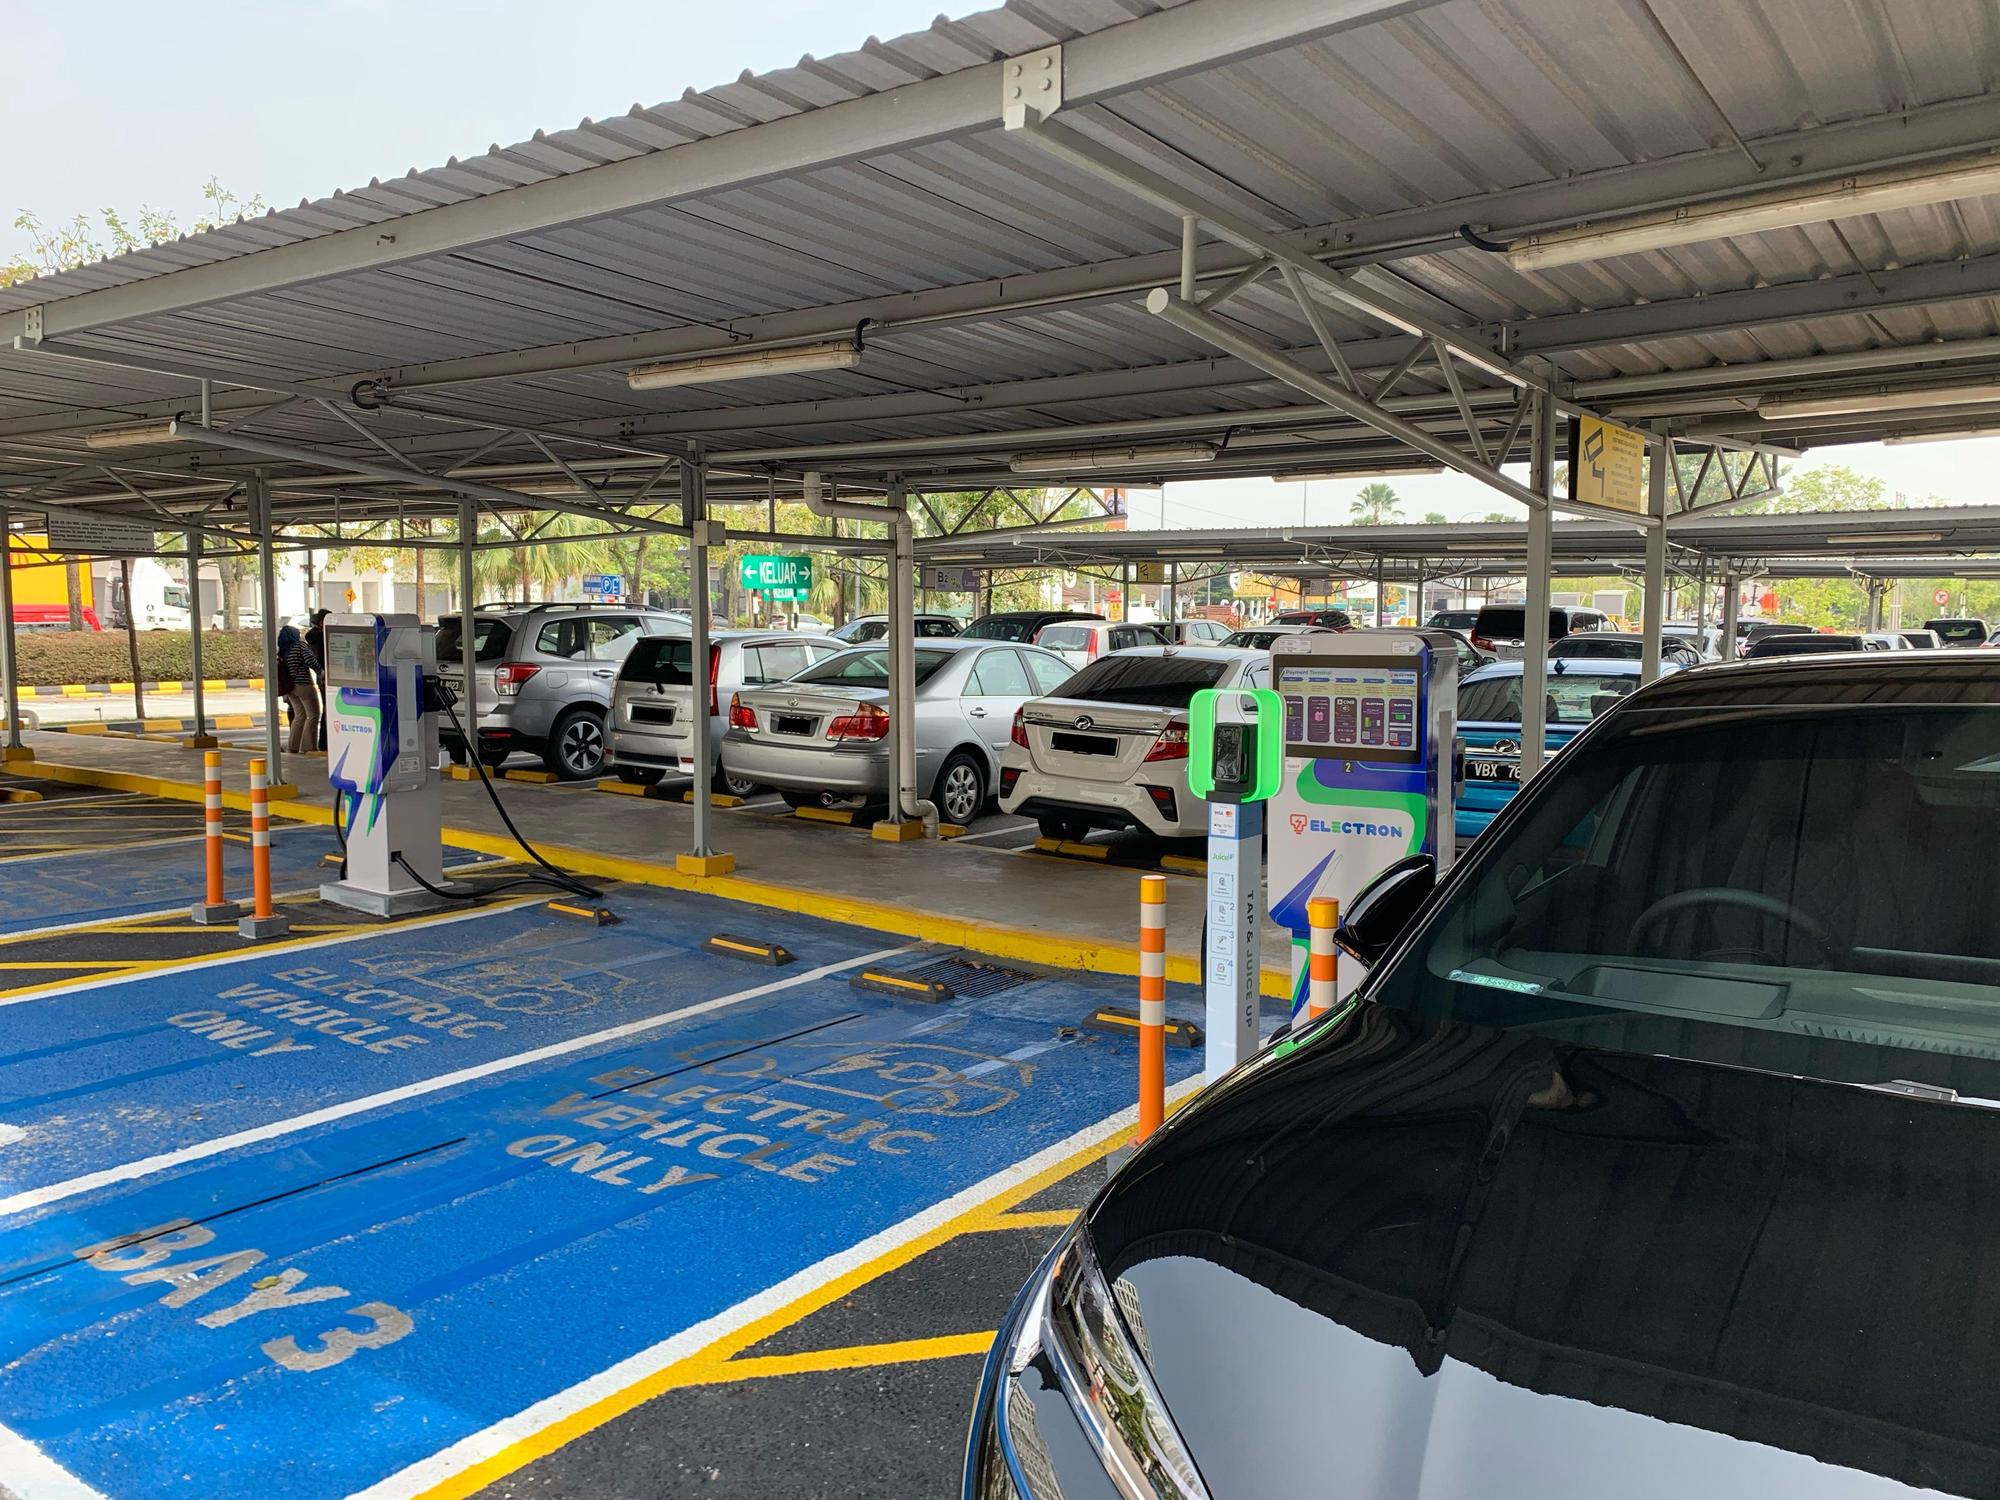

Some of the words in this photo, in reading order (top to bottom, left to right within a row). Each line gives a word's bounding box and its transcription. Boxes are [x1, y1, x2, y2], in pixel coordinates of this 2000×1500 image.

[759, 561, 798, 585] KELUAR
[341, 724, 373, 734] ELECTRON
[1345, 762, 1351, 773] 2
[1475, 763, 1498, 777] VBX
[1310, 819, 1403, 838] ELECTRON
[1246, 890, 1254, 925] TAP
[1246, 932, 1254, 943] &
[1245, 949, 1253, 1001] JUICE
[166, 1010, 316, 1058] ONLY
[216, 982, 430, 1055] VEHICLE
[1245, 1005, 1253, 1028] UP
[590, 1065, 938, 1155] ELECTRIC
[540, 1092, 858, 1183] VEHICLE
[505, 1133, 720, 1194] ONLY
[72, 1217, 351, 1329] BAY
[260, 1301, 415, 1373] 3
